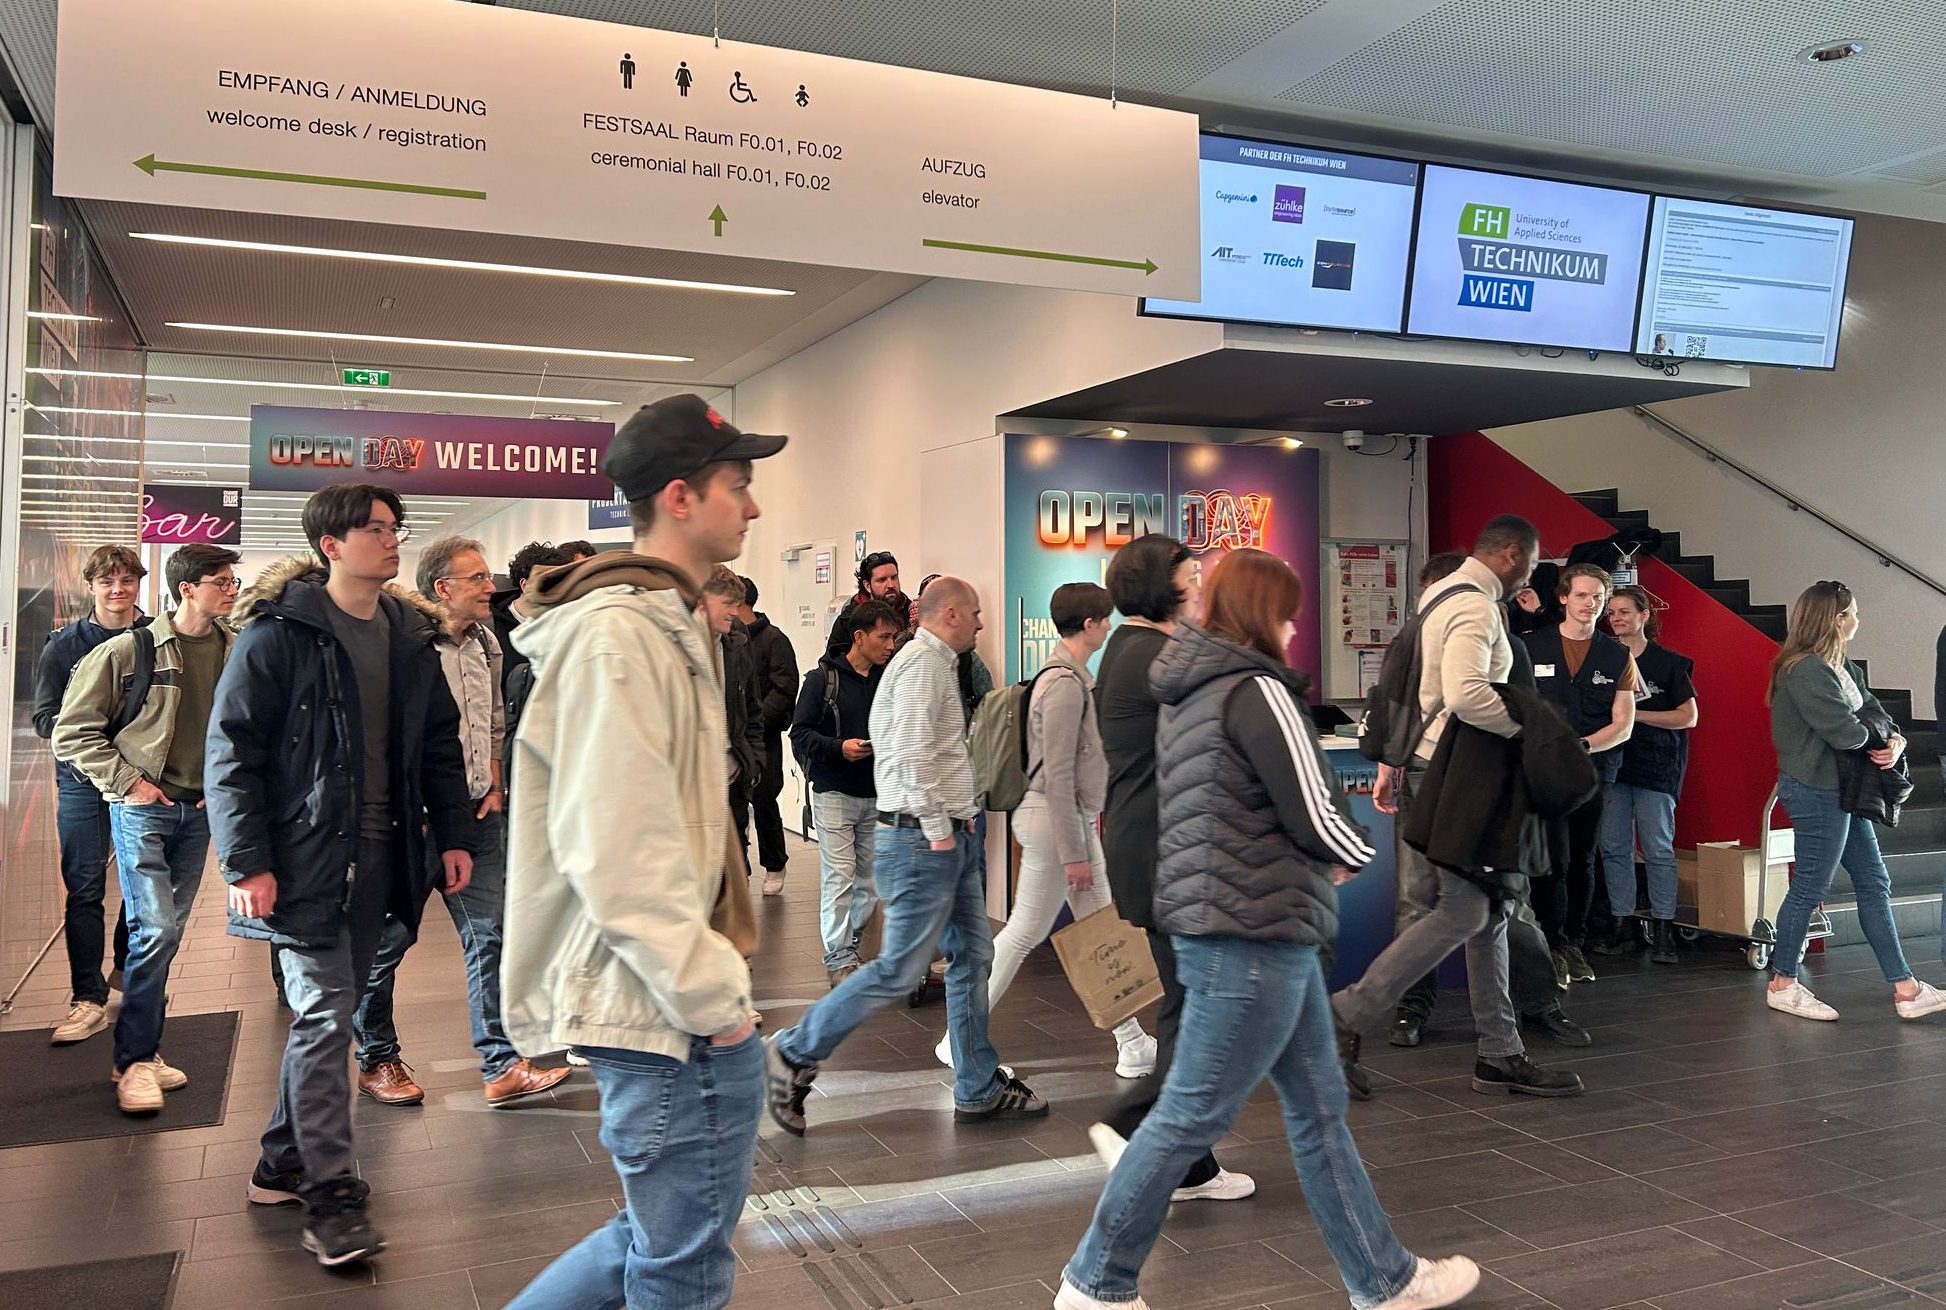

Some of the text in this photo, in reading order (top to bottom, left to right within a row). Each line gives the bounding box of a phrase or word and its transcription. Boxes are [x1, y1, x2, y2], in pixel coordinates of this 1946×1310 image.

[217, 70, 488, 117] EMPFANG / ANMELDUNG
[206, 109, 487, 153] welcome desk / registration
[582, 112, 844, 162] FESTSAAL Raum F0.01, F0.02
[590, 149, 831, 192] ceremonial hall F0.01, F0.02
[921, 157, 987, 180] AUFZUG
[1239, 147, 1347, 170] PARTNER DER FH TECHNIKUM WIEN
[922, 190, 980, 210] elevator
[1473, 208, 1503, 234] FH
[1516, 213, 1570, 230] University of
[1514, 227, 1582, 243] Applied Sciences
[1211, 246, 1234, 258] AIT
[1263, 252, 1304, 268] TTTech
[1471, 244, 1599, 280] TECHNIKUM
[1469, 279, 1527, 307] WIEN
[271, 434, 599, 475] OPEN DAY WELCOME!
[1039, 489, 1272, 553] OPEN DAY
[1023, 618, 1061, 639] CHAN
